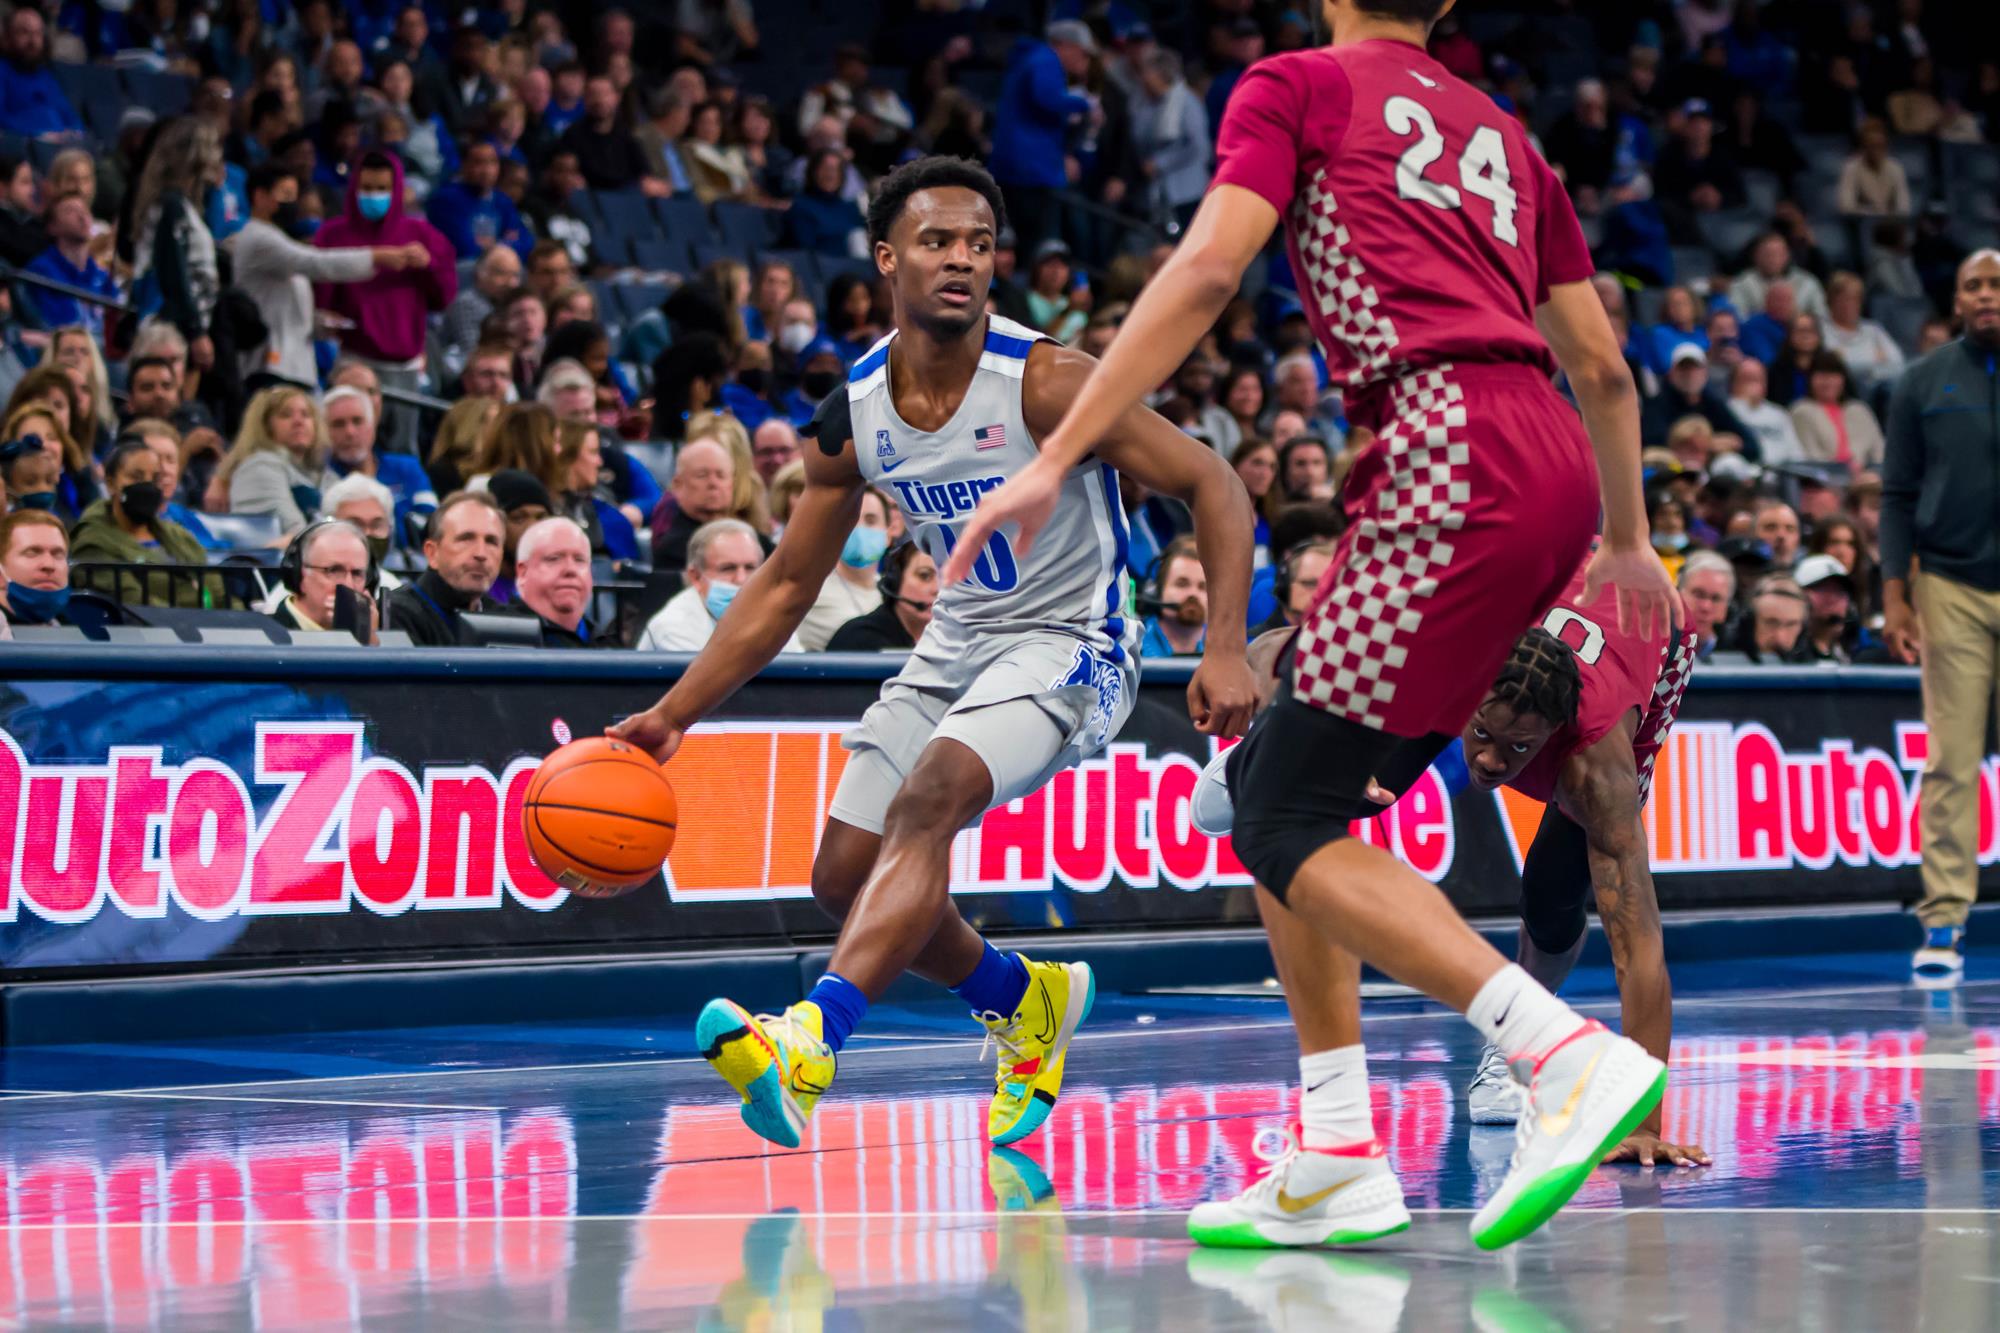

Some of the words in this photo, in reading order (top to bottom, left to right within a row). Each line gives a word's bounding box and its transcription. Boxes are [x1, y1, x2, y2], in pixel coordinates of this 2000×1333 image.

[1384, 95, 1518, 248] 24
[892, 475, 1006, 520] Tiger
[0, 721, 570, 923] utoZon
